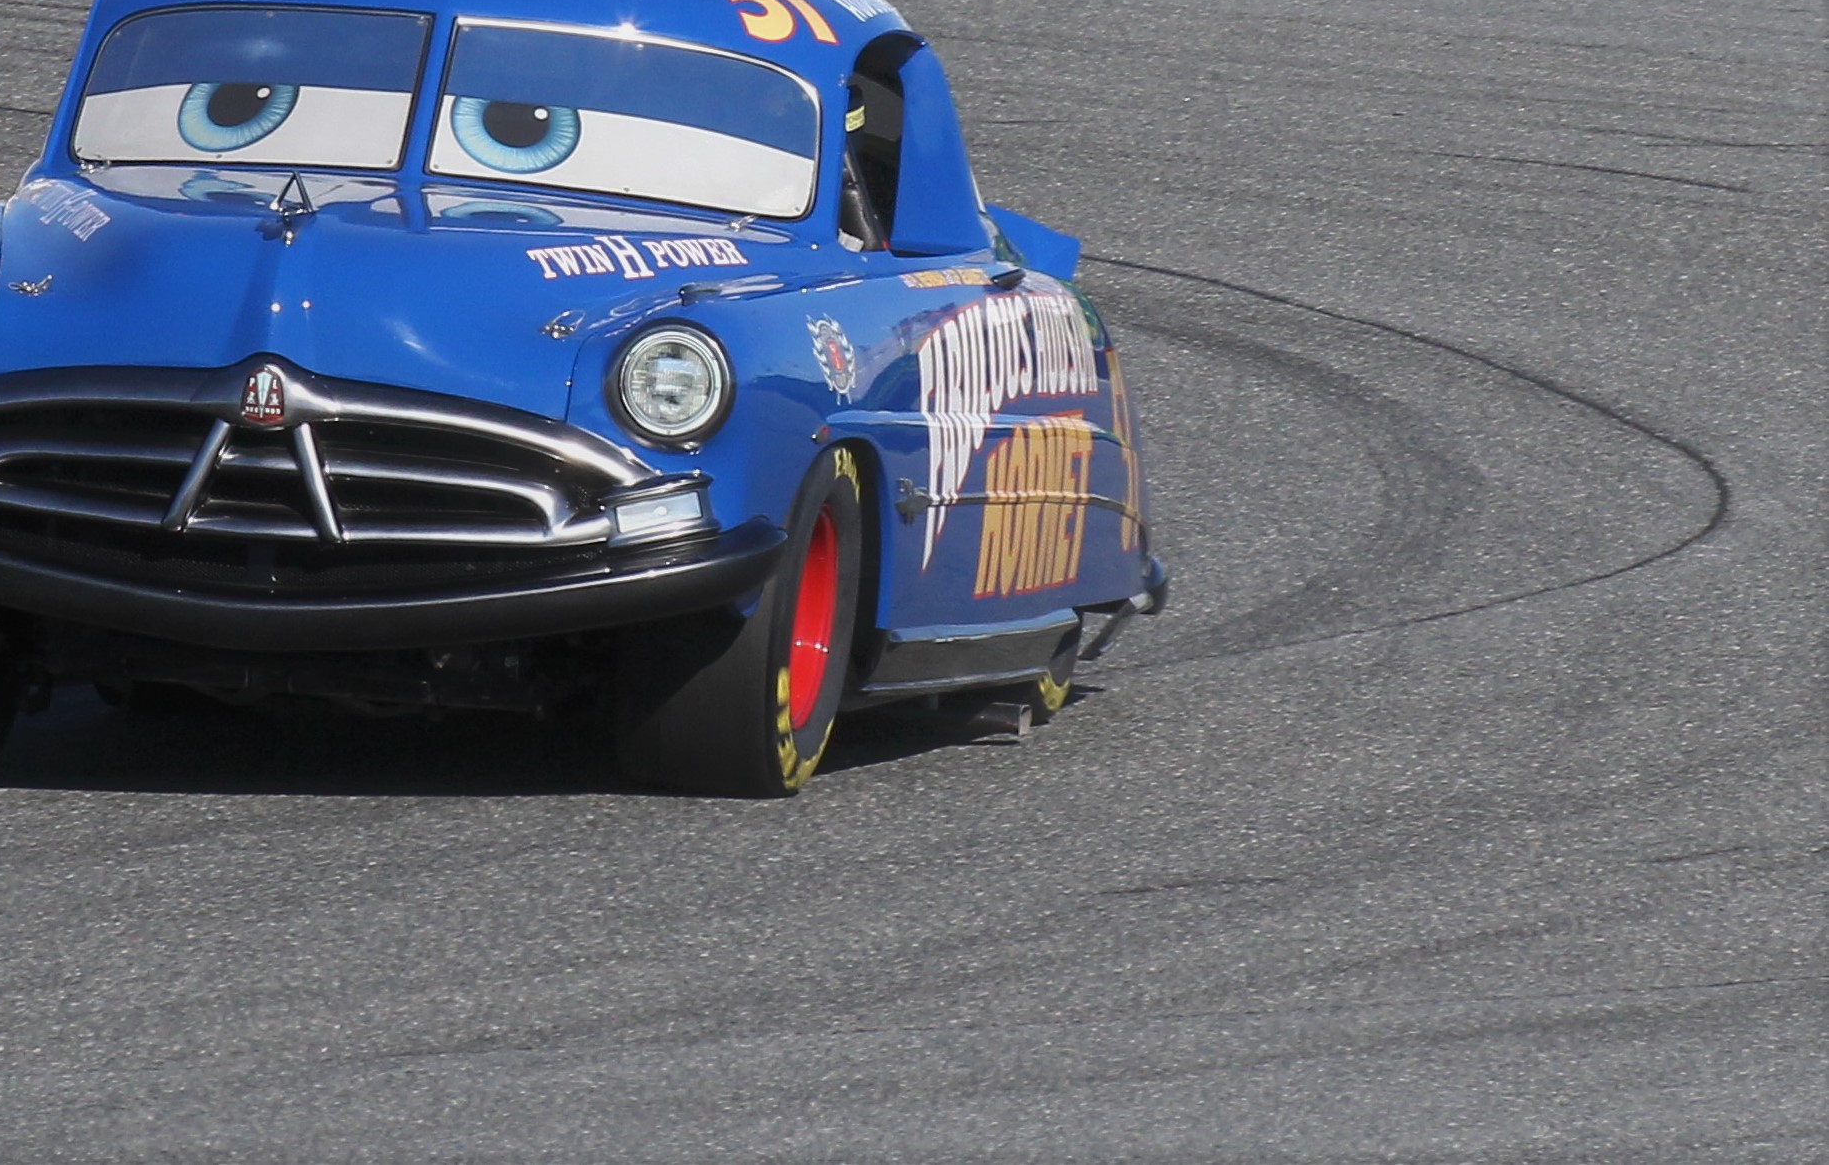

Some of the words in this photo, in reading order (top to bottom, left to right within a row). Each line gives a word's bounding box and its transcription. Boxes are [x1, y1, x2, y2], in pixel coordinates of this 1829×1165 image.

[526, 244, 616, 278] TWIN
[594, 235, 656, 279] H
[642, 238, 749, 268] POWER
[973, 410, 1093, 599] HORNET
